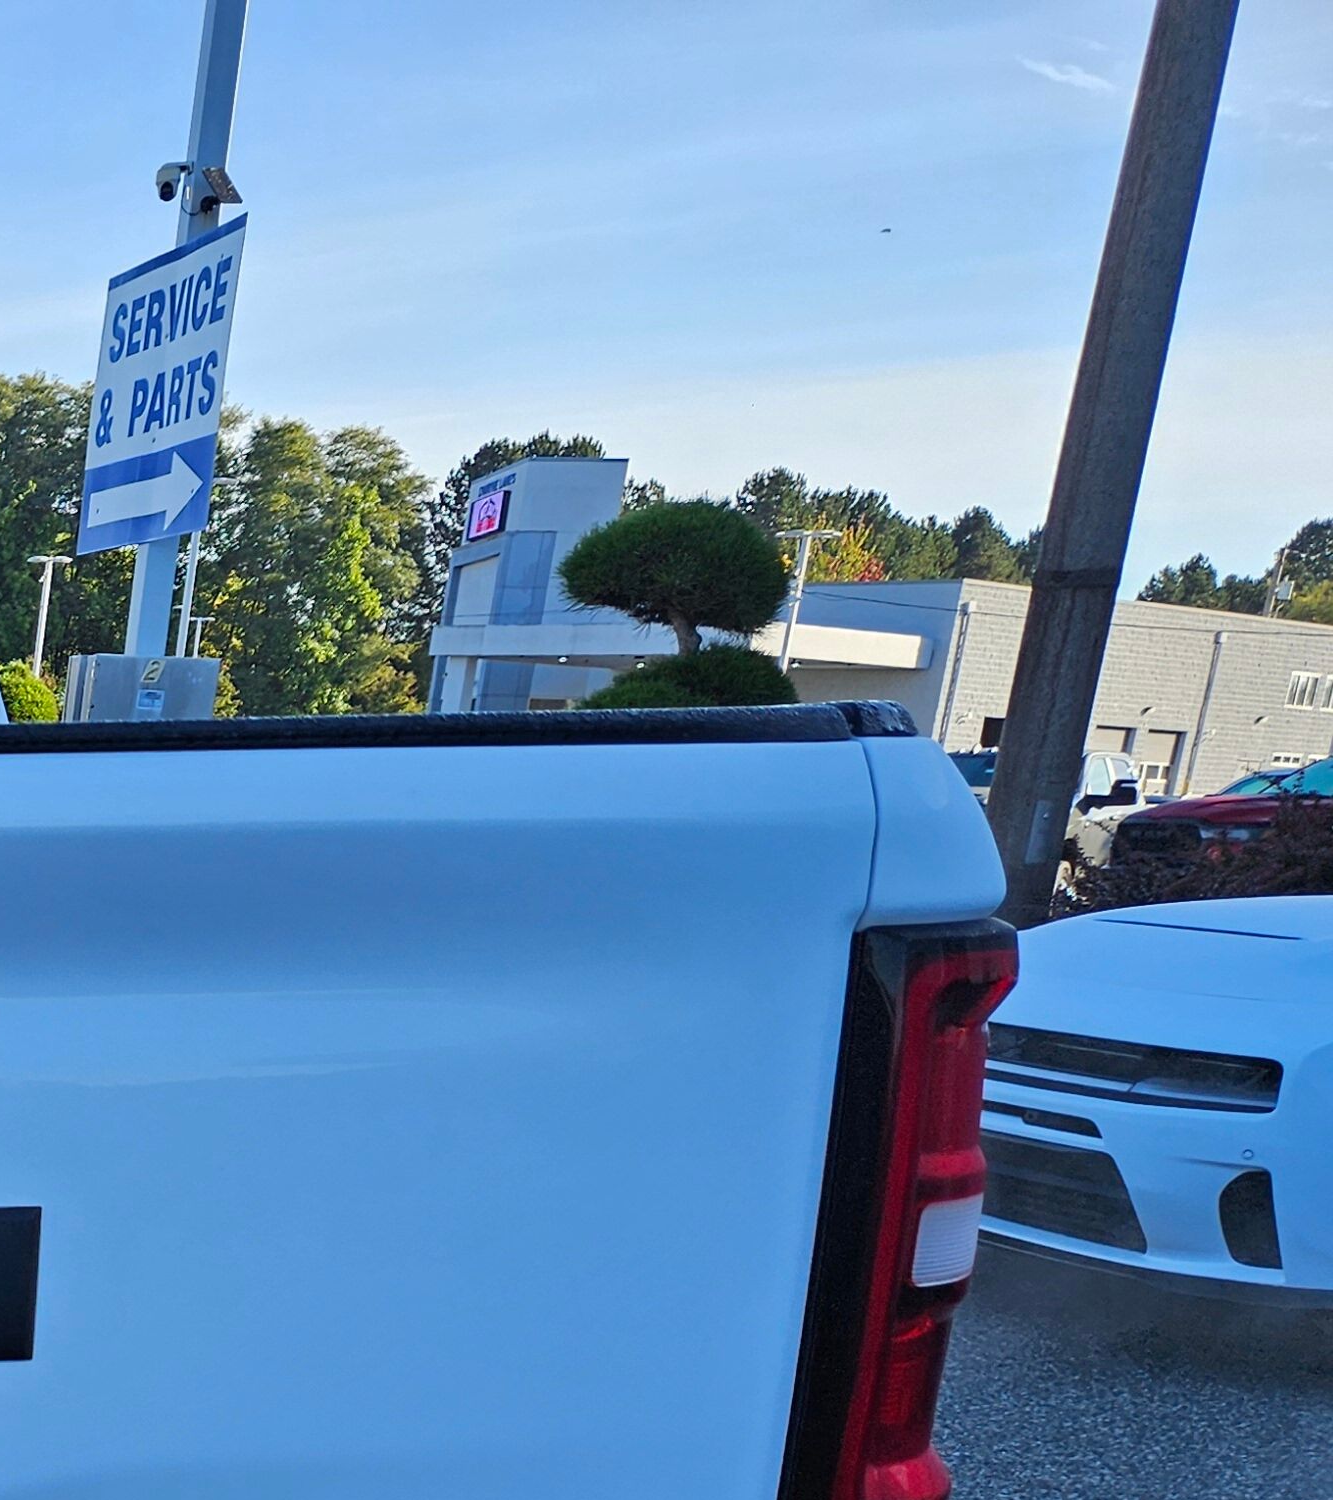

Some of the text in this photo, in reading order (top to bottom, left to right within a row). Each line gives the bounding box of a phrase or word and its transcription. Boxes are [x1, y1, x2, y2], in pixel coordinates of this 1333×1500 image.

[109, 256, 232, 363] SERVICE
[95, 350, 218, 448] & PARTS
[143, 660, 161, 681] 2
